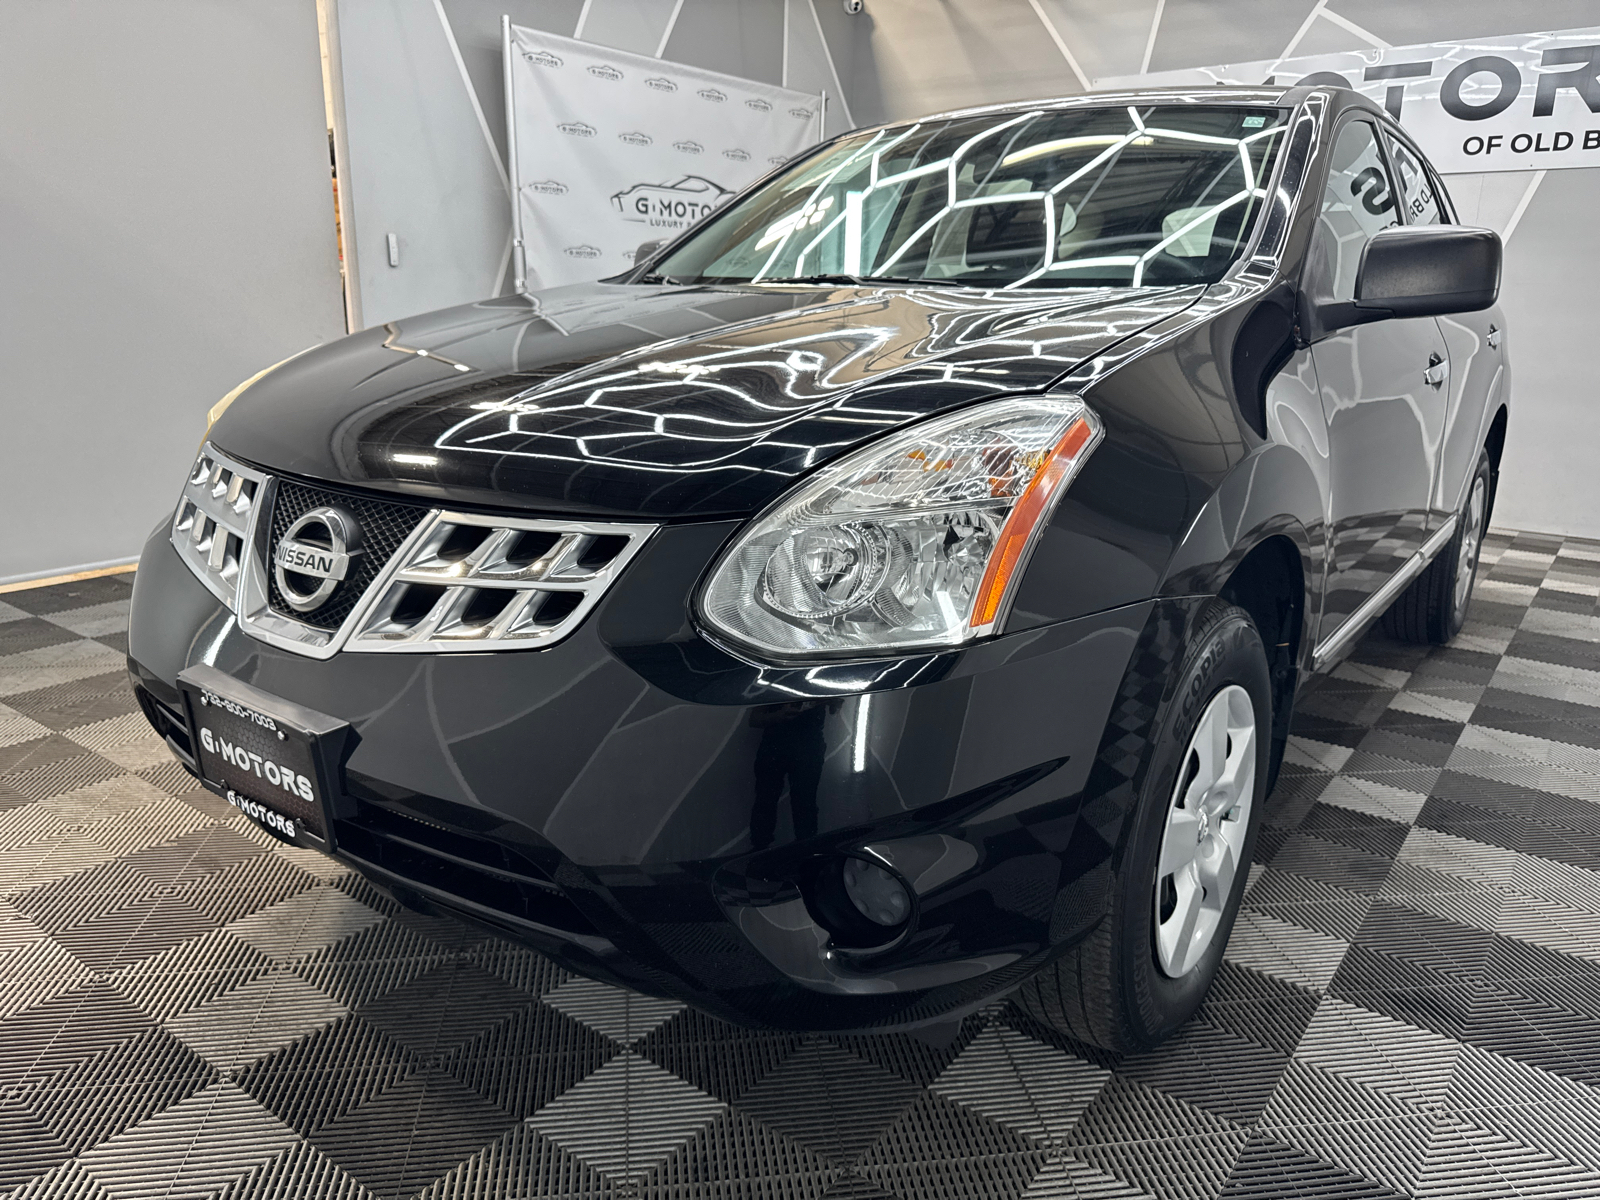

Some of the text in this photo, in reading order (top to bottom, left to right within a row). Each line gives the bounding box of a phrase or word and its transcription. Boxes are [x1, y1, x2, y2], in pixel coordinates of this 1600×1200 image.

[1462, 136, 1503, 156] OF
[1510, 131, 1574, 154] OLD
[650, 219, 683, 229] LUXURY
[276, 544, 333, 573] NISSAN
